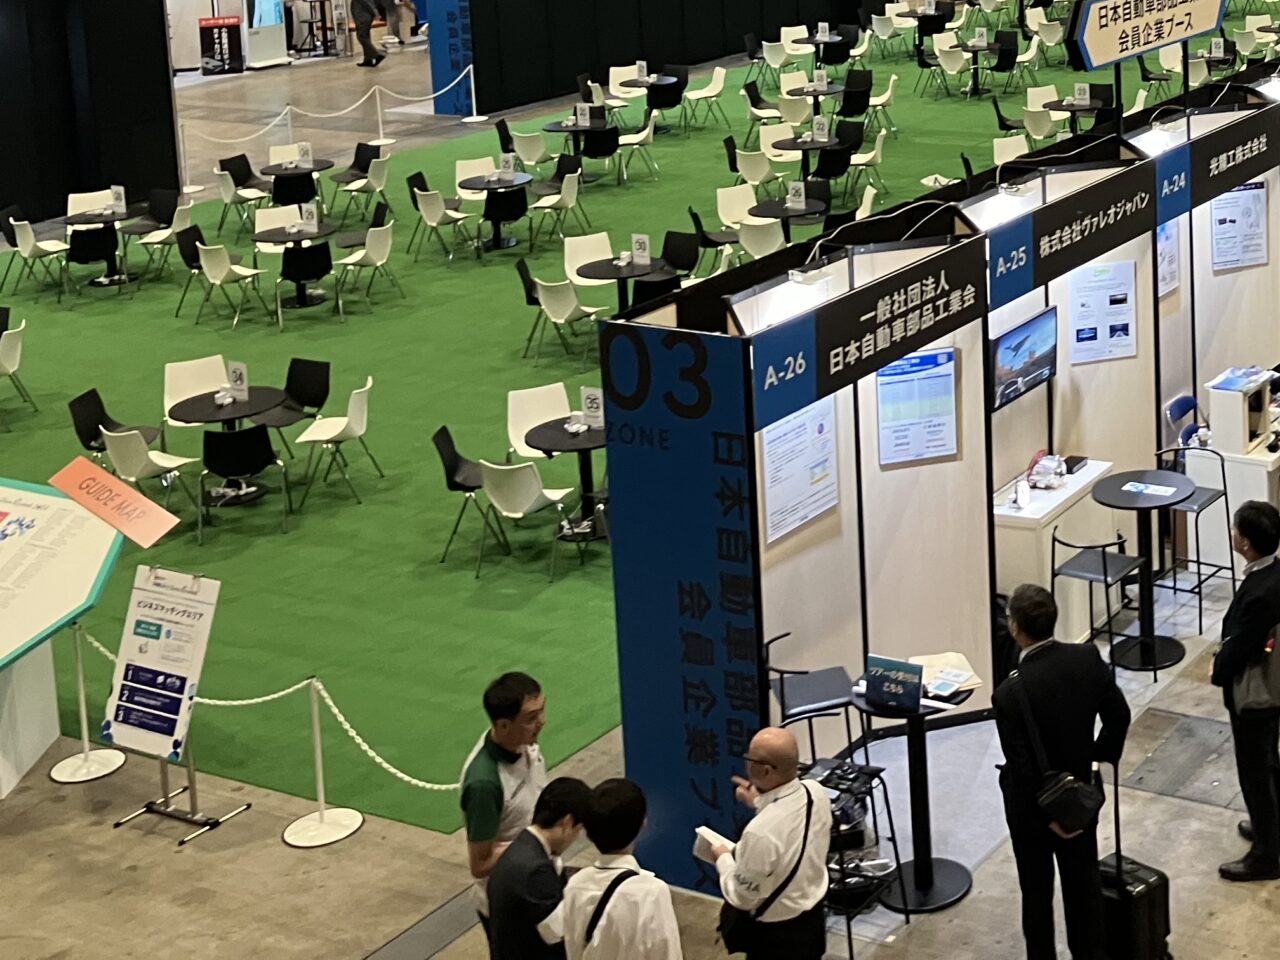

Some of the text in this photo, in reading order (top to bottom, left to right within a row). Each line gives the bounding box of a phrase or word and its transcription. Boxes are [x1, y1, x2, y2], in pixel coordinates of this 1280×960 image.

[1117, 11, 1194, 53] 会員企業ブース
[1161, 172, 1187, 198] A-24
[1039, 191, 1151, 259] 株式会社ヴァレオジャパン
[995, 245, 1028, 278] A-25
[859, 269, 950, 324] 一般社団法人
[829, 283, 976, 376] 日本自動車部品工業会
[232, 369, 244, 385] 34
[603, 326, 713, 421] 03
[763, 351, 807, 391] A-26
[585, 396, 600, 411] 35
[603, 422, 670, 451] ZONE
[77, 476, 148, 523] GUIDE MAP
[136, 599, 205, 622] ビジネスマッチングエリア
[126, 668, 133, 681] 1
[121, 689, 129, 702] 2
[116, 709, 125, 722] 3
